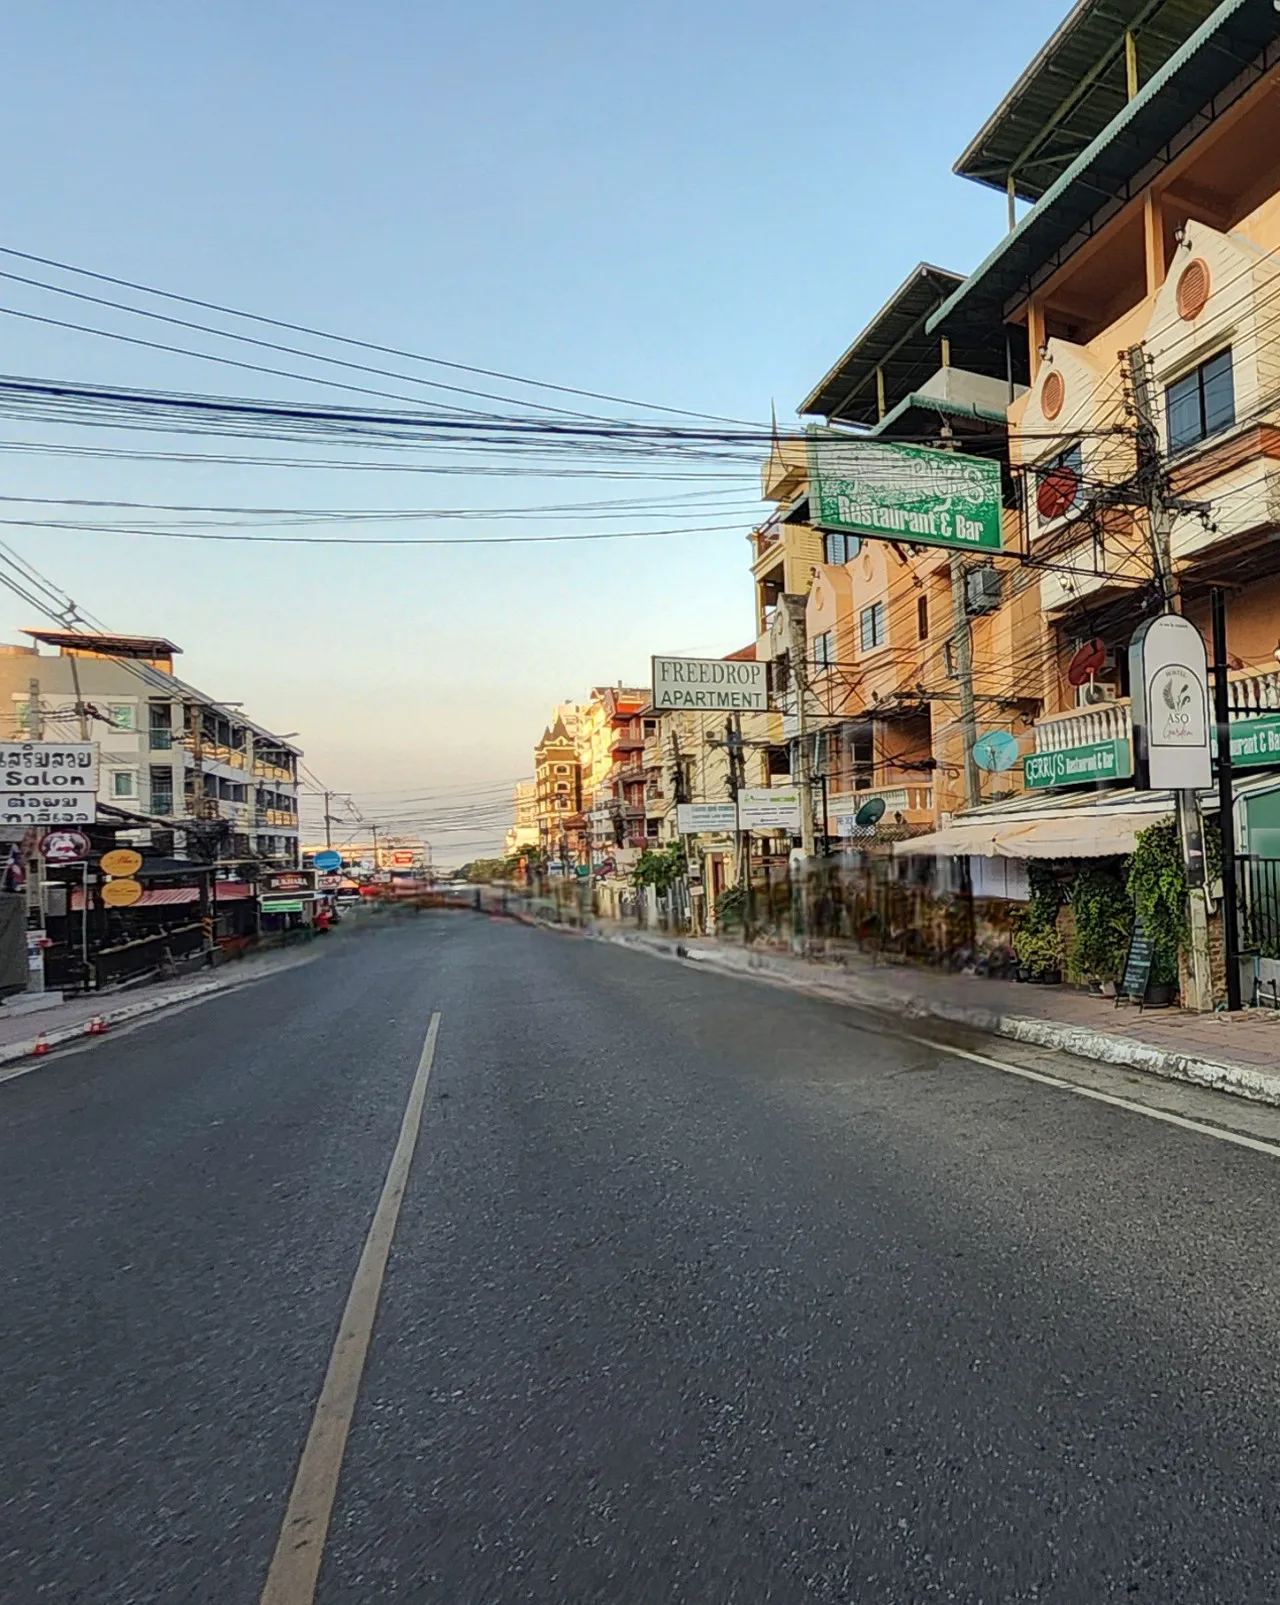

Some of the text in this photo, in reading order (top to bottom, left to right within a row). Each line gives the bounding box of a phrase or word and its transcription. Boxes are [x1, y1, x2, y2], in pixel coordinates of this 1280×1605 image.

[837, 495, 938, 536] Restaurant
[955, 515, 984, 542] Bar
[660, 661, 761, 685] FREEDROP
[661, 690, 762, 708] APARTMENT
[1168, 713, 1190, 724] ASO
[0, 744, 92, 769] เสริมสวย
[5, 770, 85, 786] Salon
